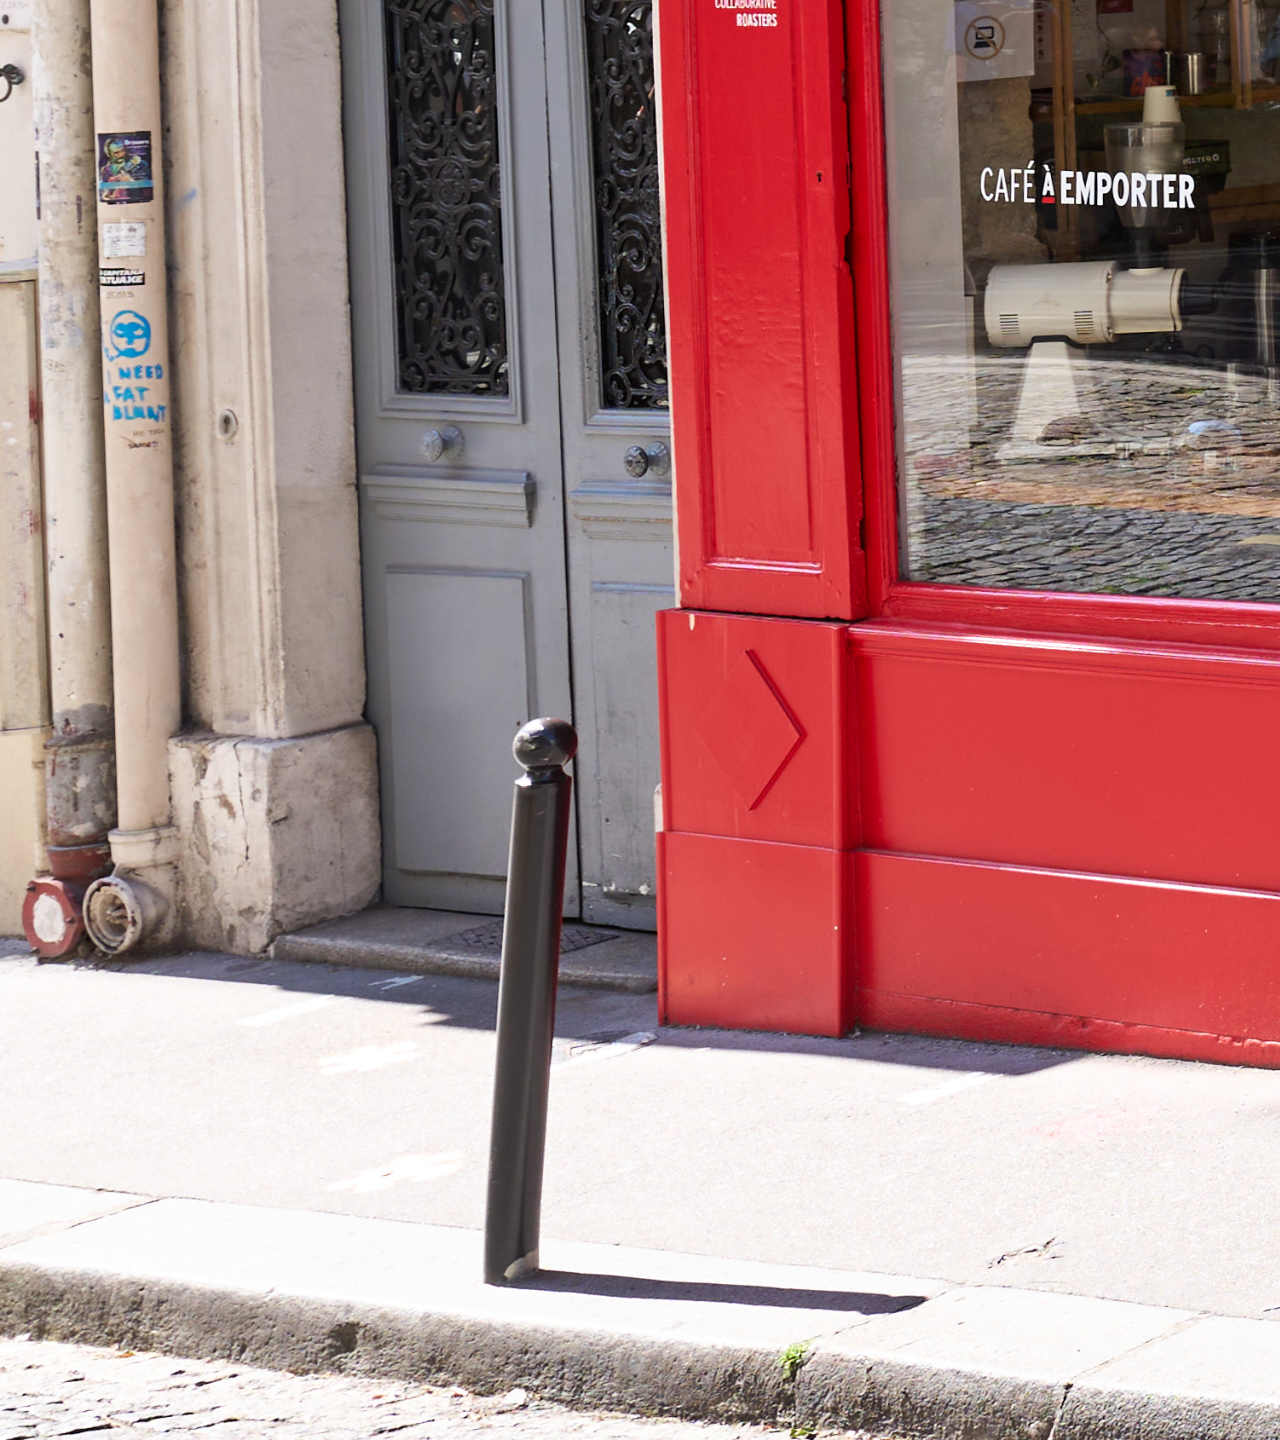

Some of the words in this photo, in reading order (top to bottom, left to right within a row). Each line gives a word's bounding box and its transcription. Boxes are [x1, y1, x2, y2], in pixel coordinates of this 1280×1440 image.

[737, 13, 778, 27] ROASTERS
[980, 160, 1036, 204] CAFÉ
[1042, 164, 1055, 197] À
[1060, 170, 1195, 209] EMPORTER
[118, 364, 164, 379] NEED
[112, 386, 151, 402] FAT
[113, 404, 167, 423] BLUNT
